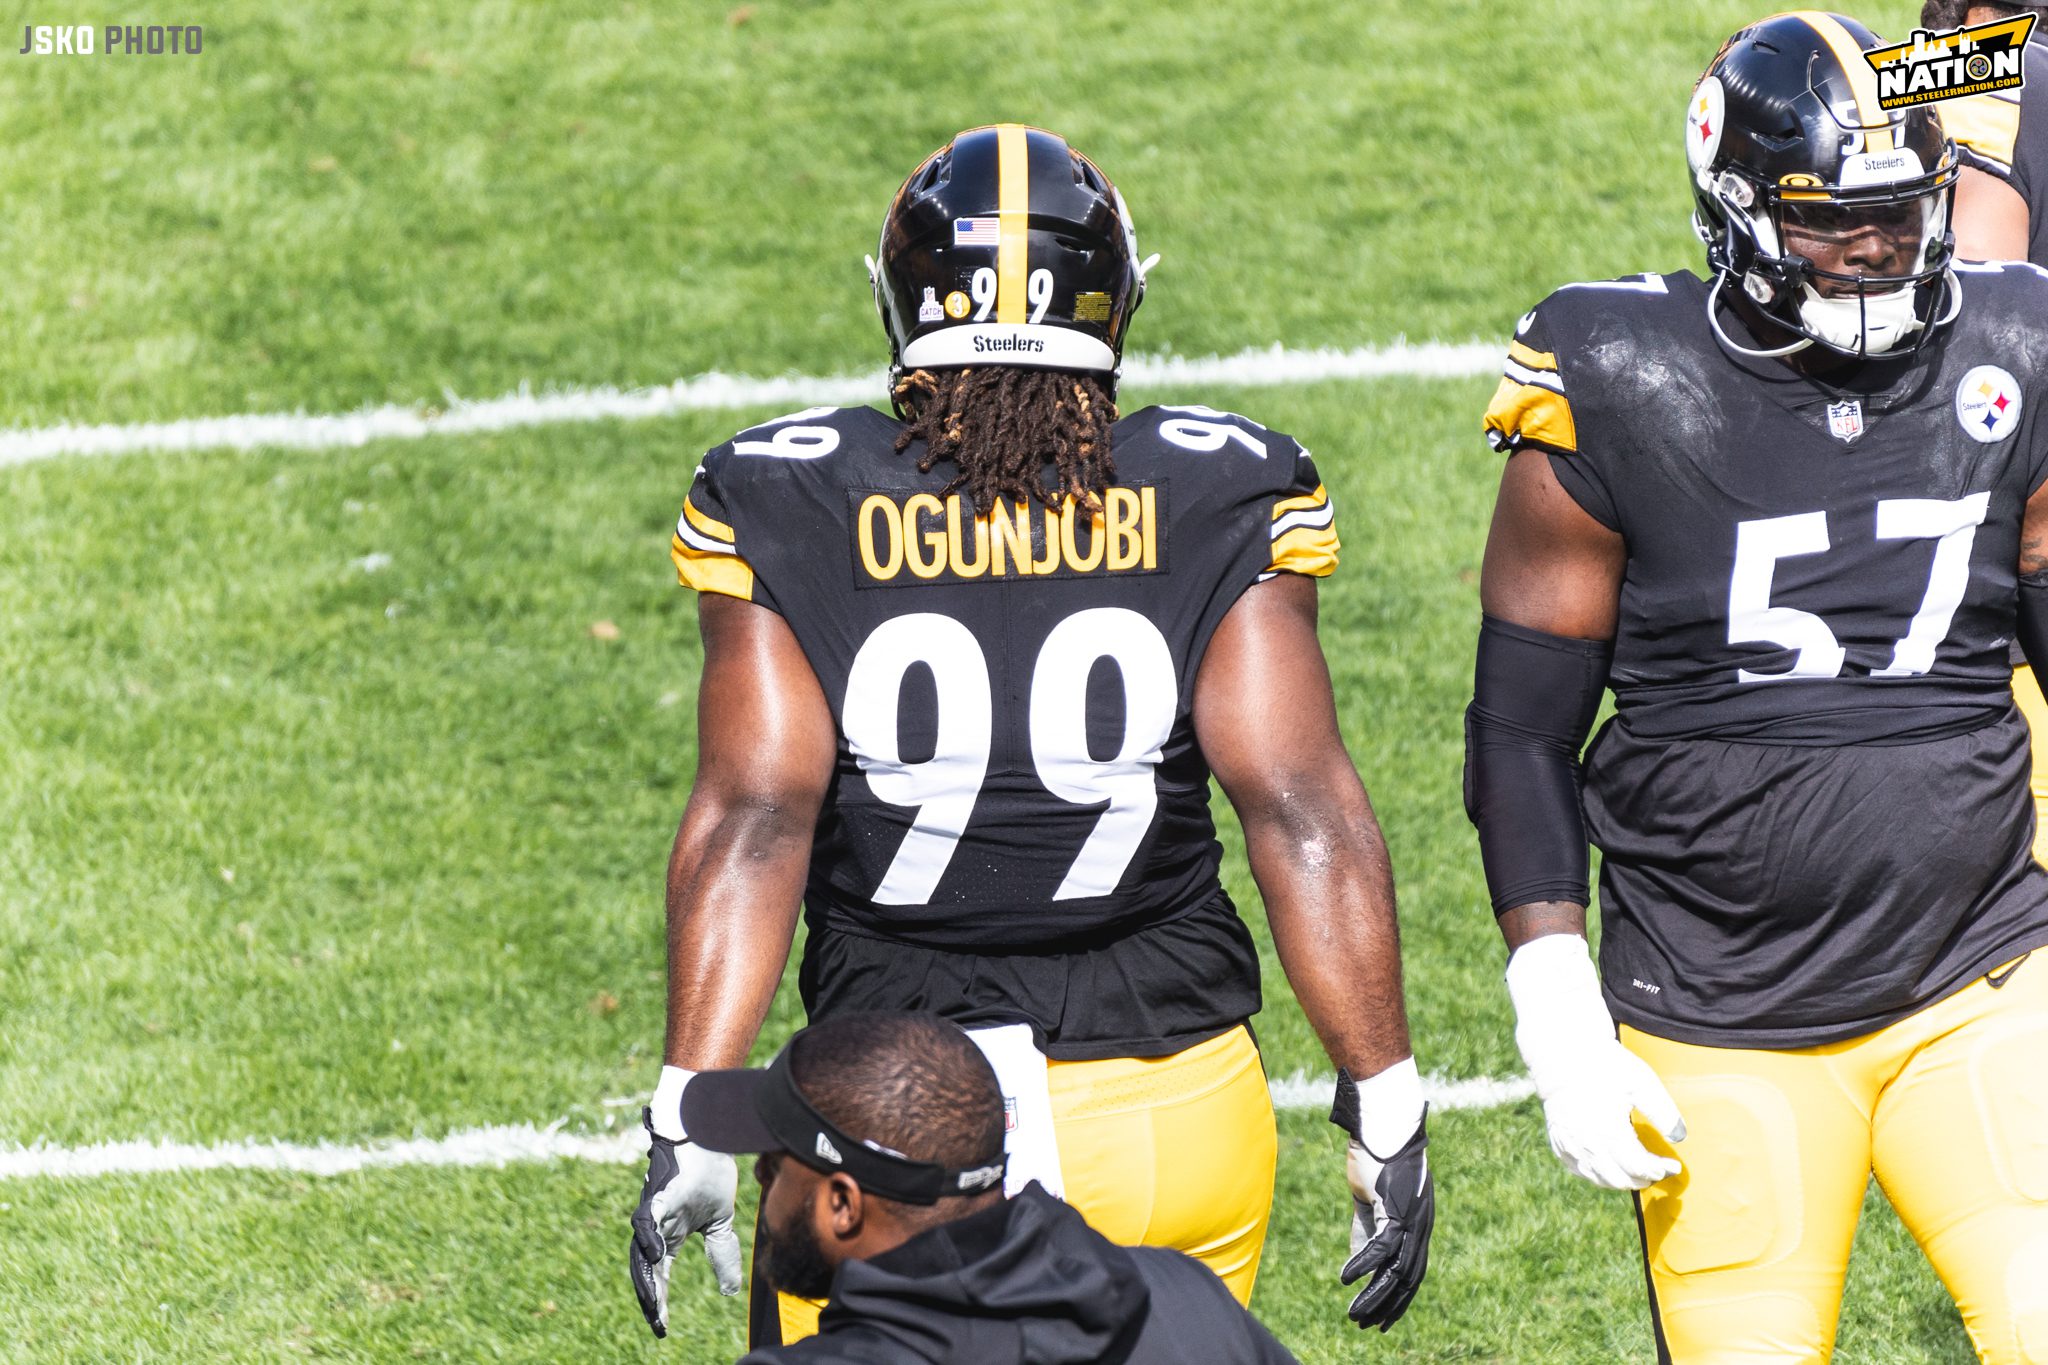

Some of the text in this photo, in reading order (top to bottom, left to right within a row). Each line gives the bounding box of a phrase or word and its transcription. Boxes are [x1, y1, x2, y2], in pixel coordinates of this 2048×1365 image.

[1864, 155, 1905, 171] Steelers
[951, 292, 963, 316] 3
[973, 333, 1044, 353] Steelers
[857, 486, 1158, 580] OGUNJOBI
[1727, 491, 1990, 684] 57
[842, 607, 1178, 905] 99
